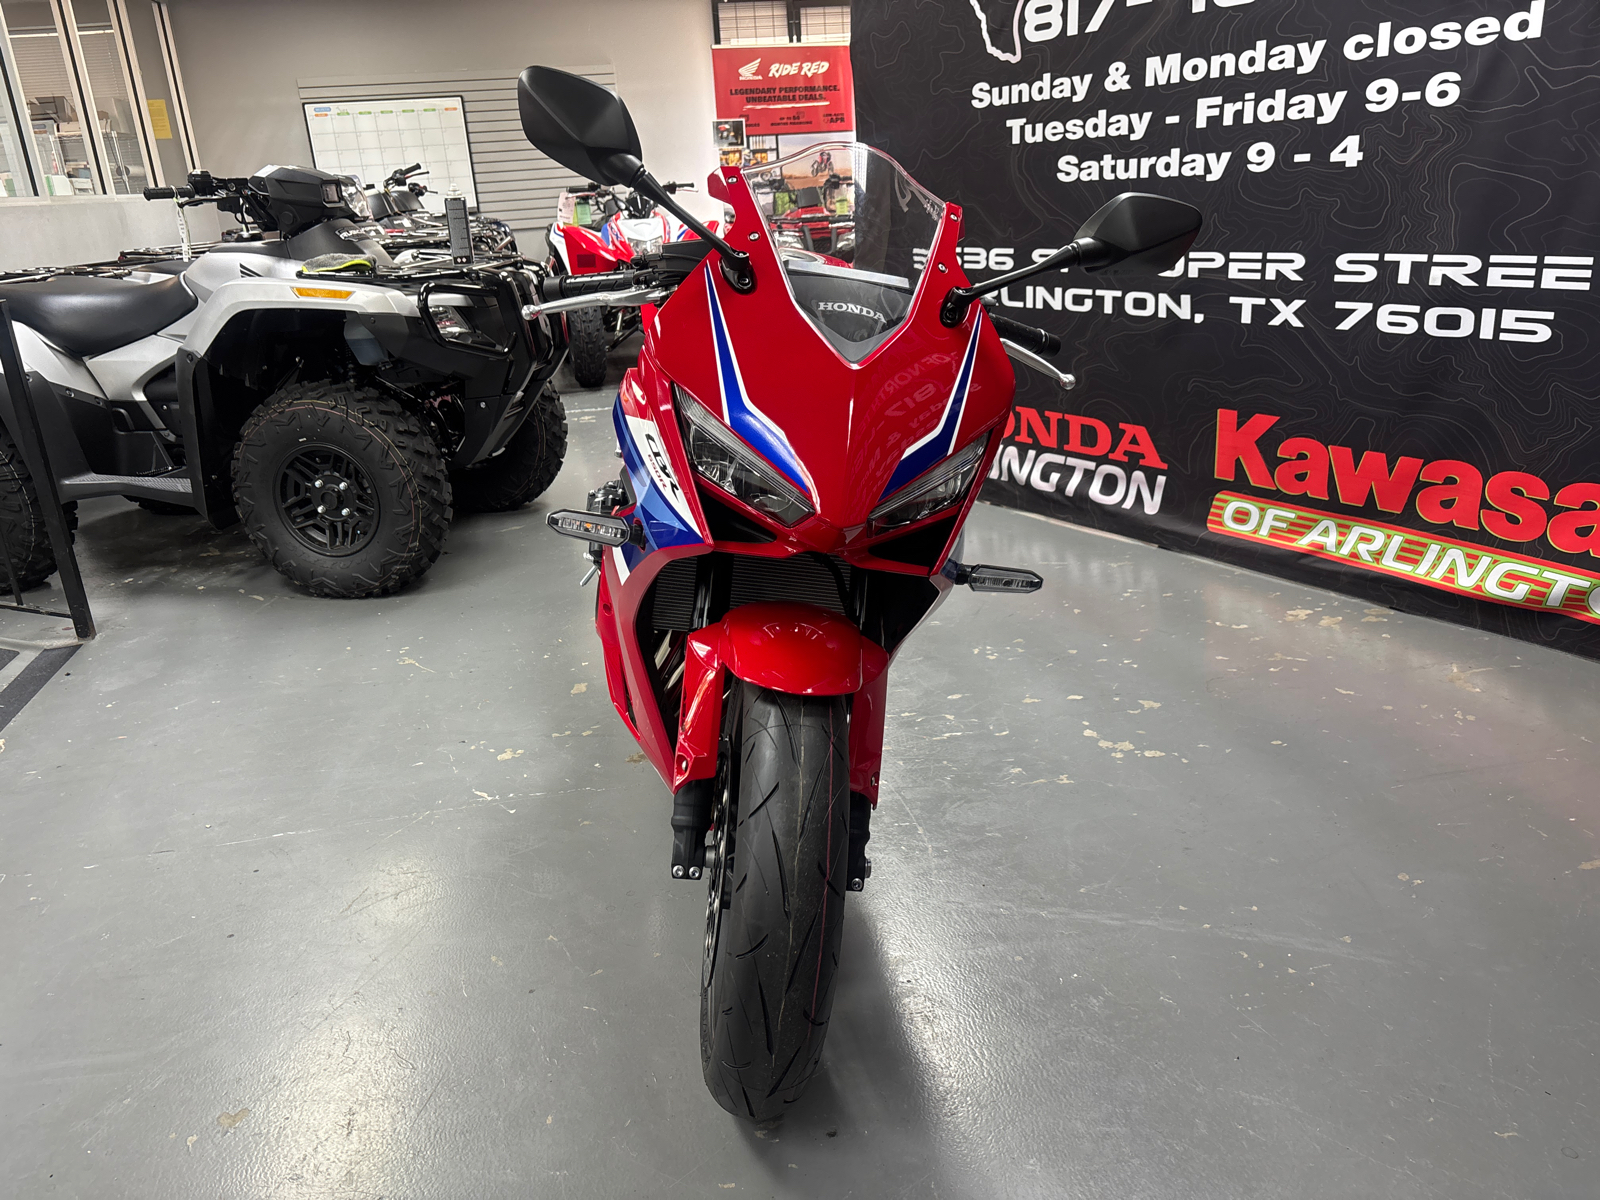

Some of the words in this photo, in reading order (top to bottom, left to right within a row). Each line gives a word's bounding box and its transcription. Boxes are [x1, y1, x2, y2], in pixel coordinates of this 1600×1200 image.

[768, 62, 801, 78] RIDE
[800, 60, 830, 78] RED
[971, 73, 1093, 109] Sunday
[1104, 62, 1132, 92] &
[1145, 40, 1328, 88] Monday
[1342, 0, 1546, 61] closed
[730, 87, 777, 96] LEGENDARY
[778, 85, 840, 94] PERFORMANCE.
[745, 94, 797, 103] UNBEATABLE
[798, 93, 826, 101] DEALS.
[1006, 109, 1153, 145] Tuesday
[1165, 115, 1180, 125] -
[1195, 88, 1348, 129] Friday
[1364, 71, 1462, 113] 9-6
[1056, 147, 1233, 183] Saturday
[1246, 141, 1276, 172] 9
[1293, 153, 1311, 163] -
[1329, 134, 1364, 168] 4
[1333, 252, 1595, 291] STREE
[818, 302, 887, 325] HONDA
[979, 284, 1205, 324] LINGTON,
[1229, 296, 1307, 328] TX
[1334, 301, 1555, 343] 76015
[645, 433, 680, 502] CBR
[1003, 405, 1169, 470] NDA
[987, 444, 1168, 516] INGTON
[1213, 408, 1600, 558] Kawasa
[1222, 500, 1296, 537] OF
[1296, 518, 1600, 616] ARLINGT
